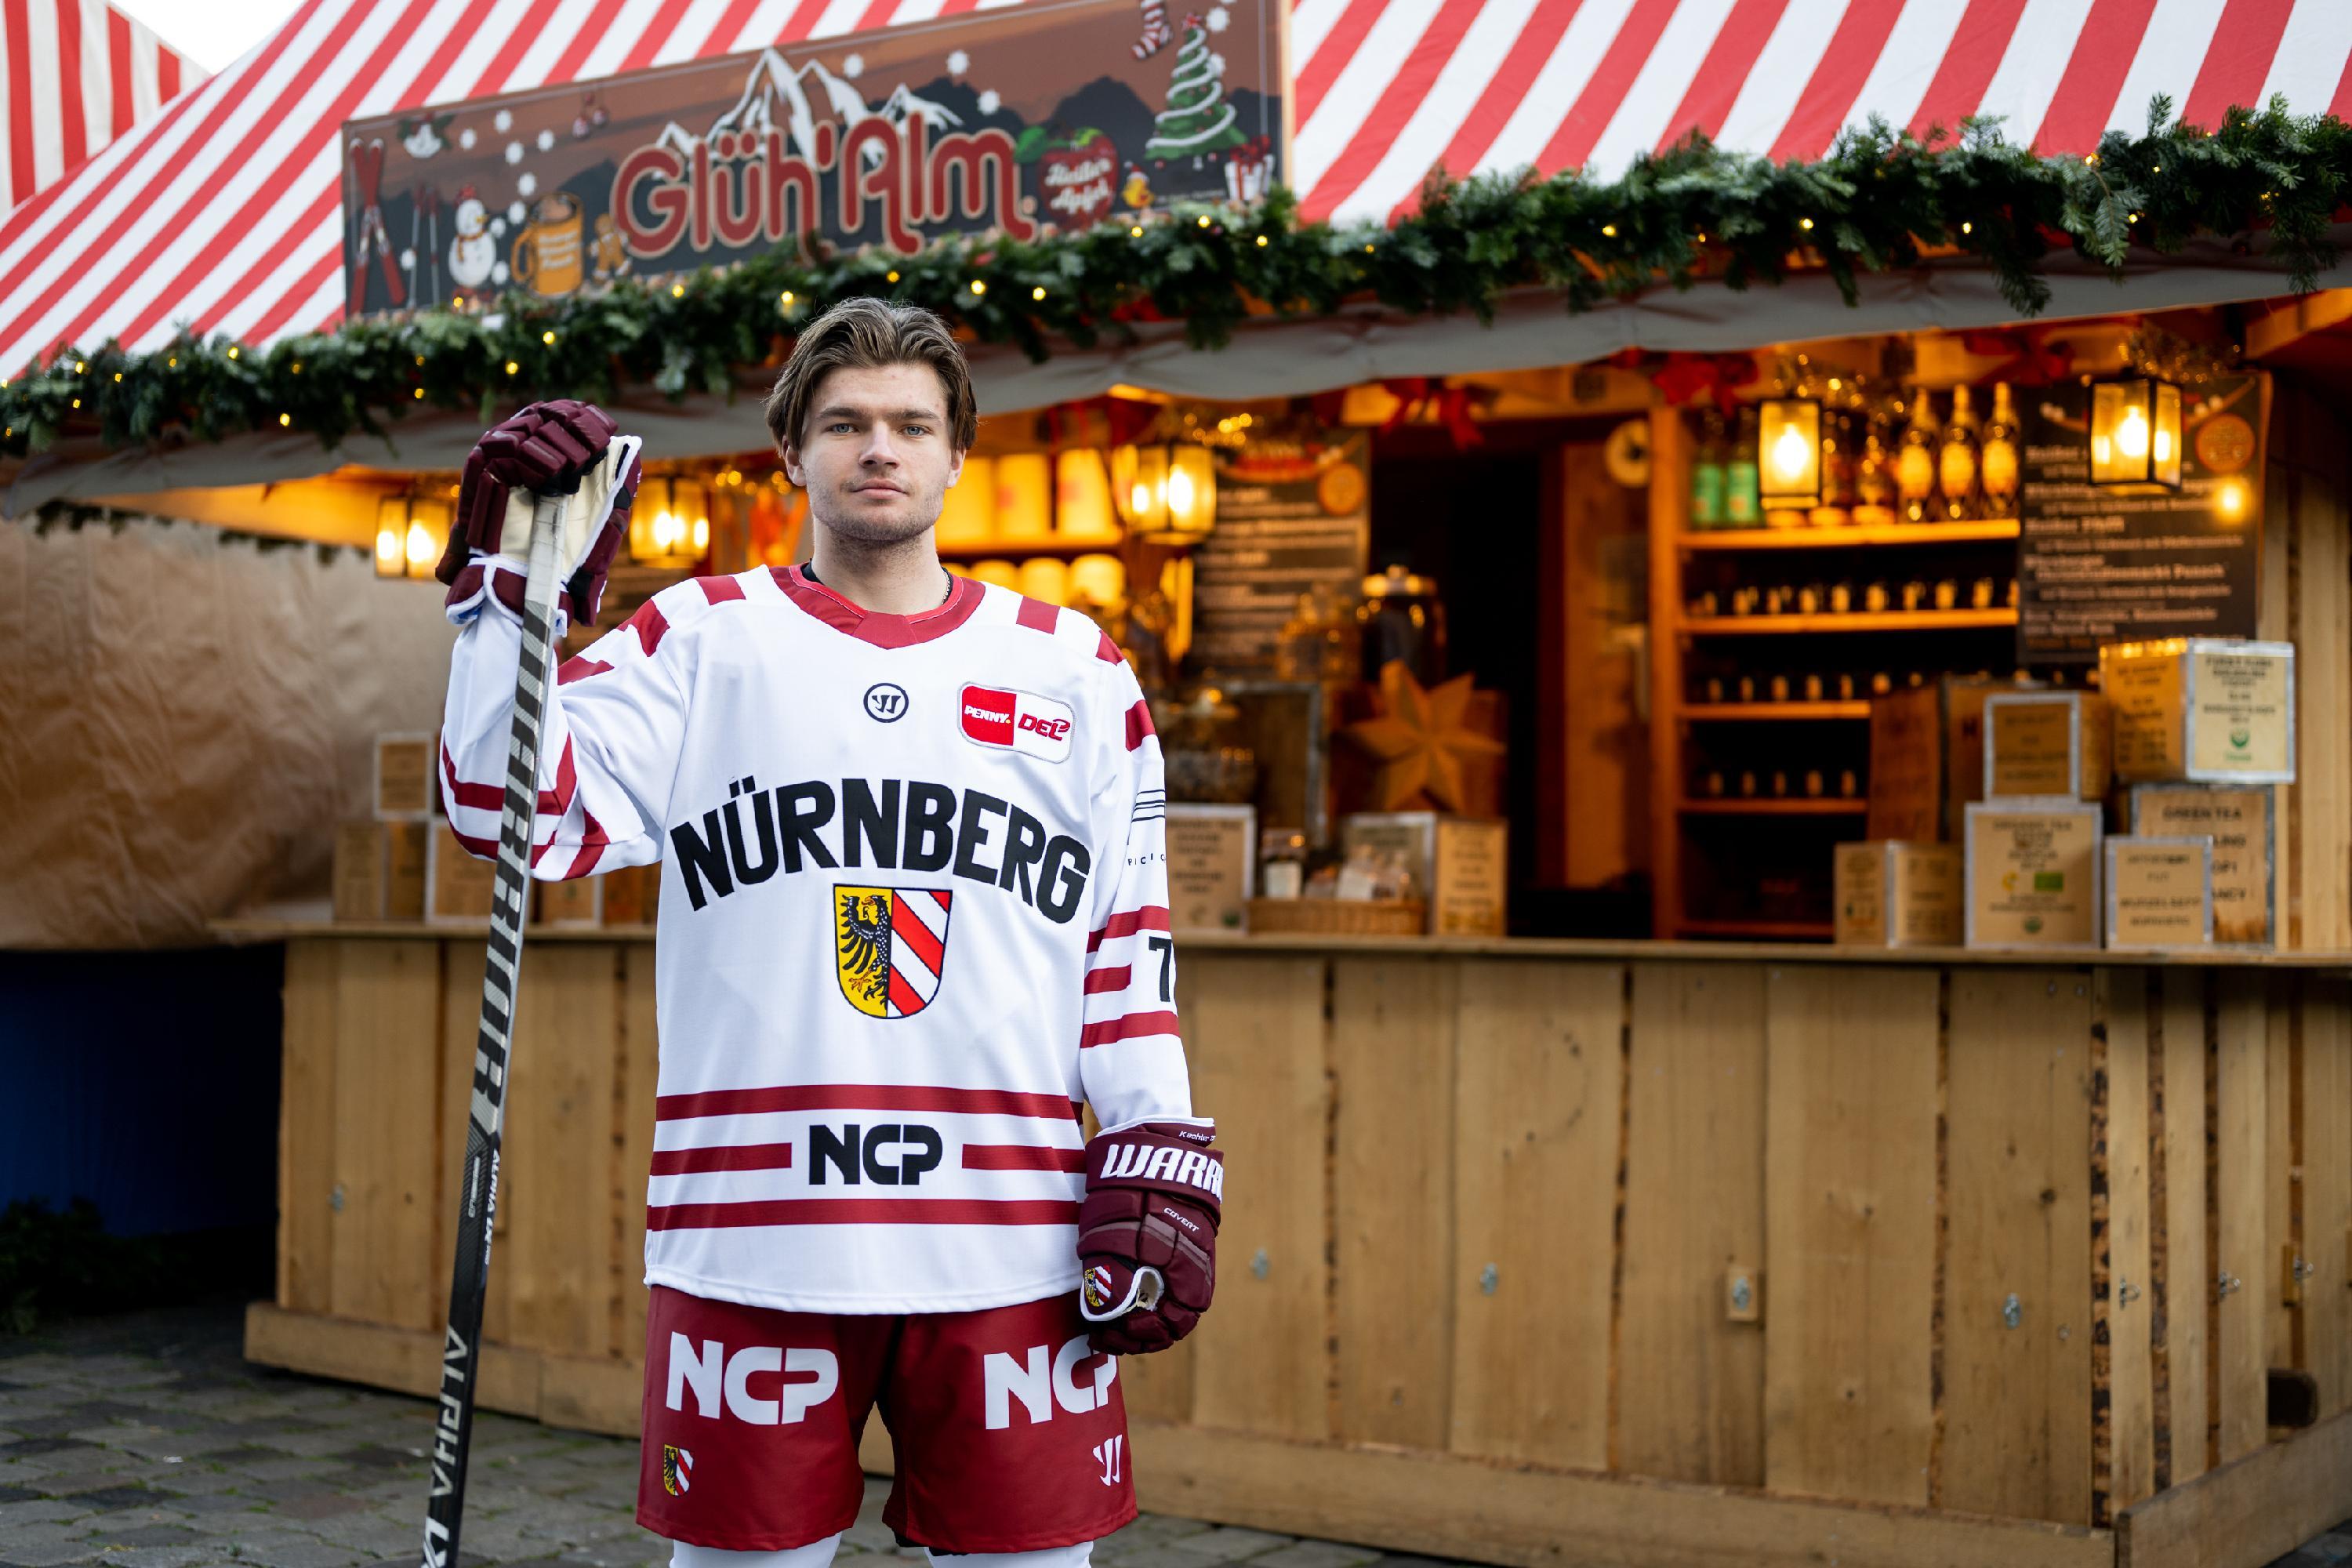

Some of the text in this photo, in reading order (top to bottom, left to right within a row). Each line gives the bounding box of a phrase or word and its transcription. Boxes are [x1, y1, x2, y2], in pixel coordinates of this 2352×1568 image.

[611, 109, 1036, 265] Glüh'Alm
[670, 776, 1091, 924] NÜRNBERG
[487, 1148, 501, 1213] ALPHA
[808, 1123, 942, 1185] NCP
[1163, 1207, 1200, 1232] COVERT
[430, 1323, 469, 1497] ALPHA
[666, 1331, 840, 1425] NCP
